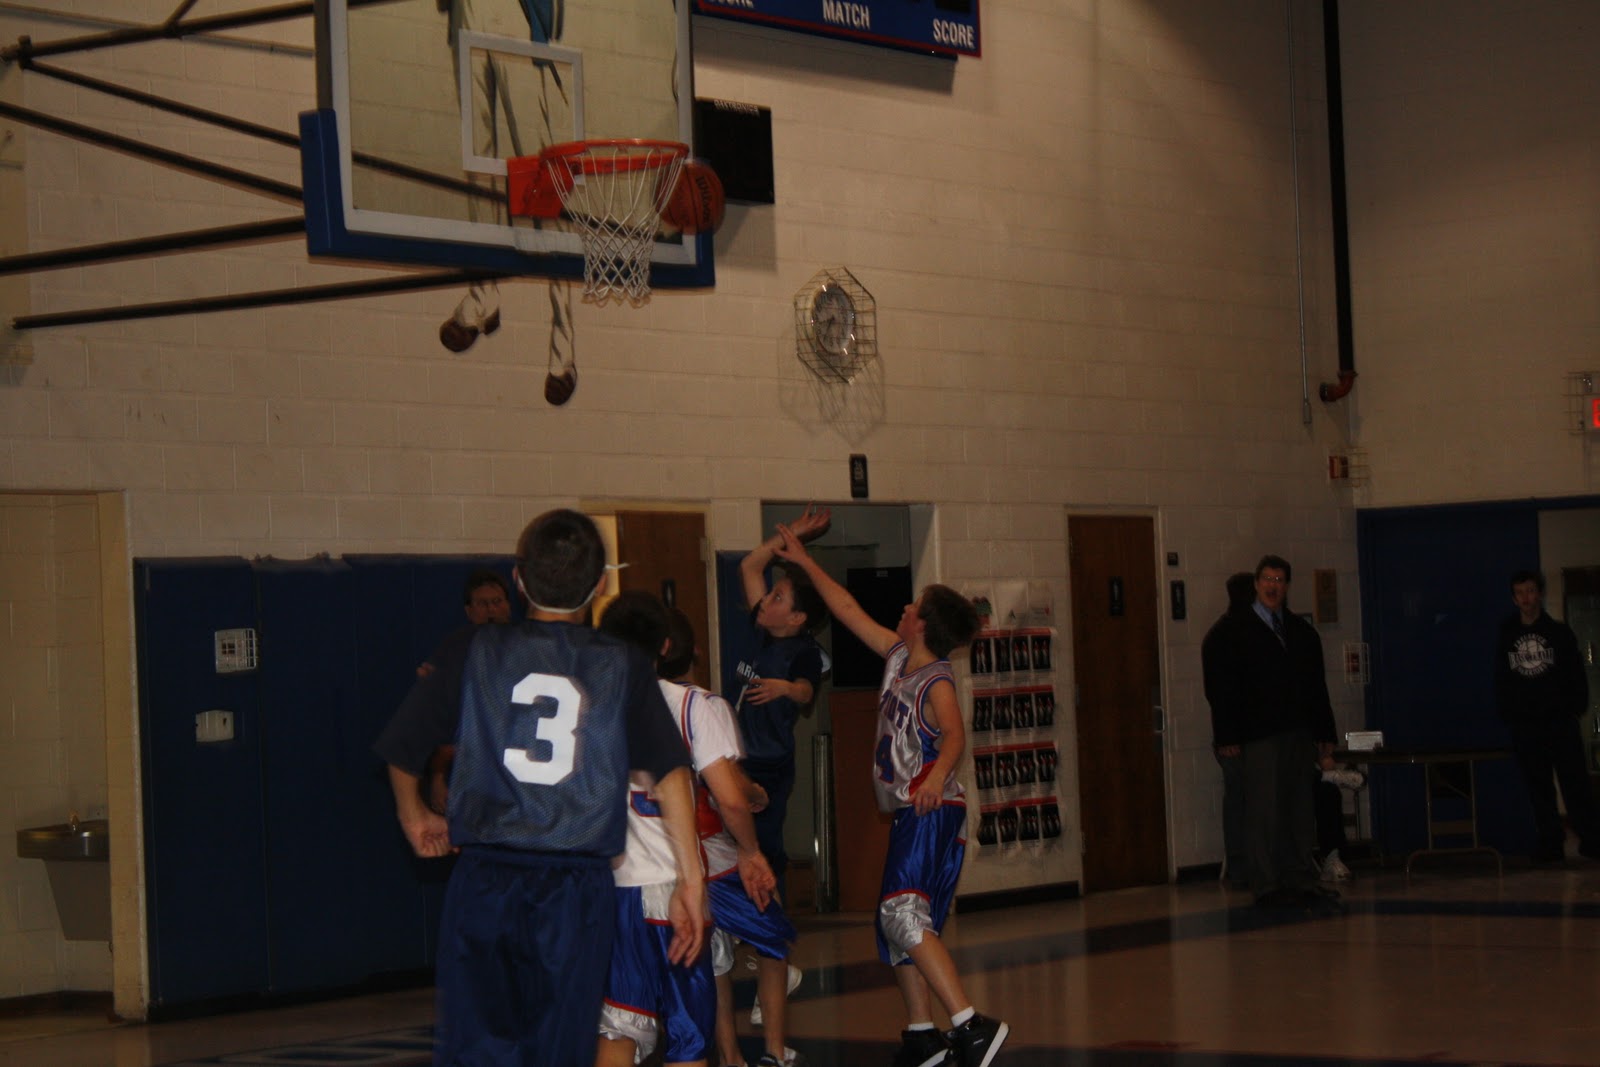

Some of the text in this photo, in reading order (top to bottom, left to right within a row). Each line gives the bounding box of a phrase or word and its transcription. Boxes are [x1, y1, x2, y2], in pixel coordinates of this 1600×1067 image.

[822, 0, 872, 30] MATCH
[932, 18, 976, 48] SCORE
[503, 672, 582, 787] 3
[876, 735, 893, 783] 4
